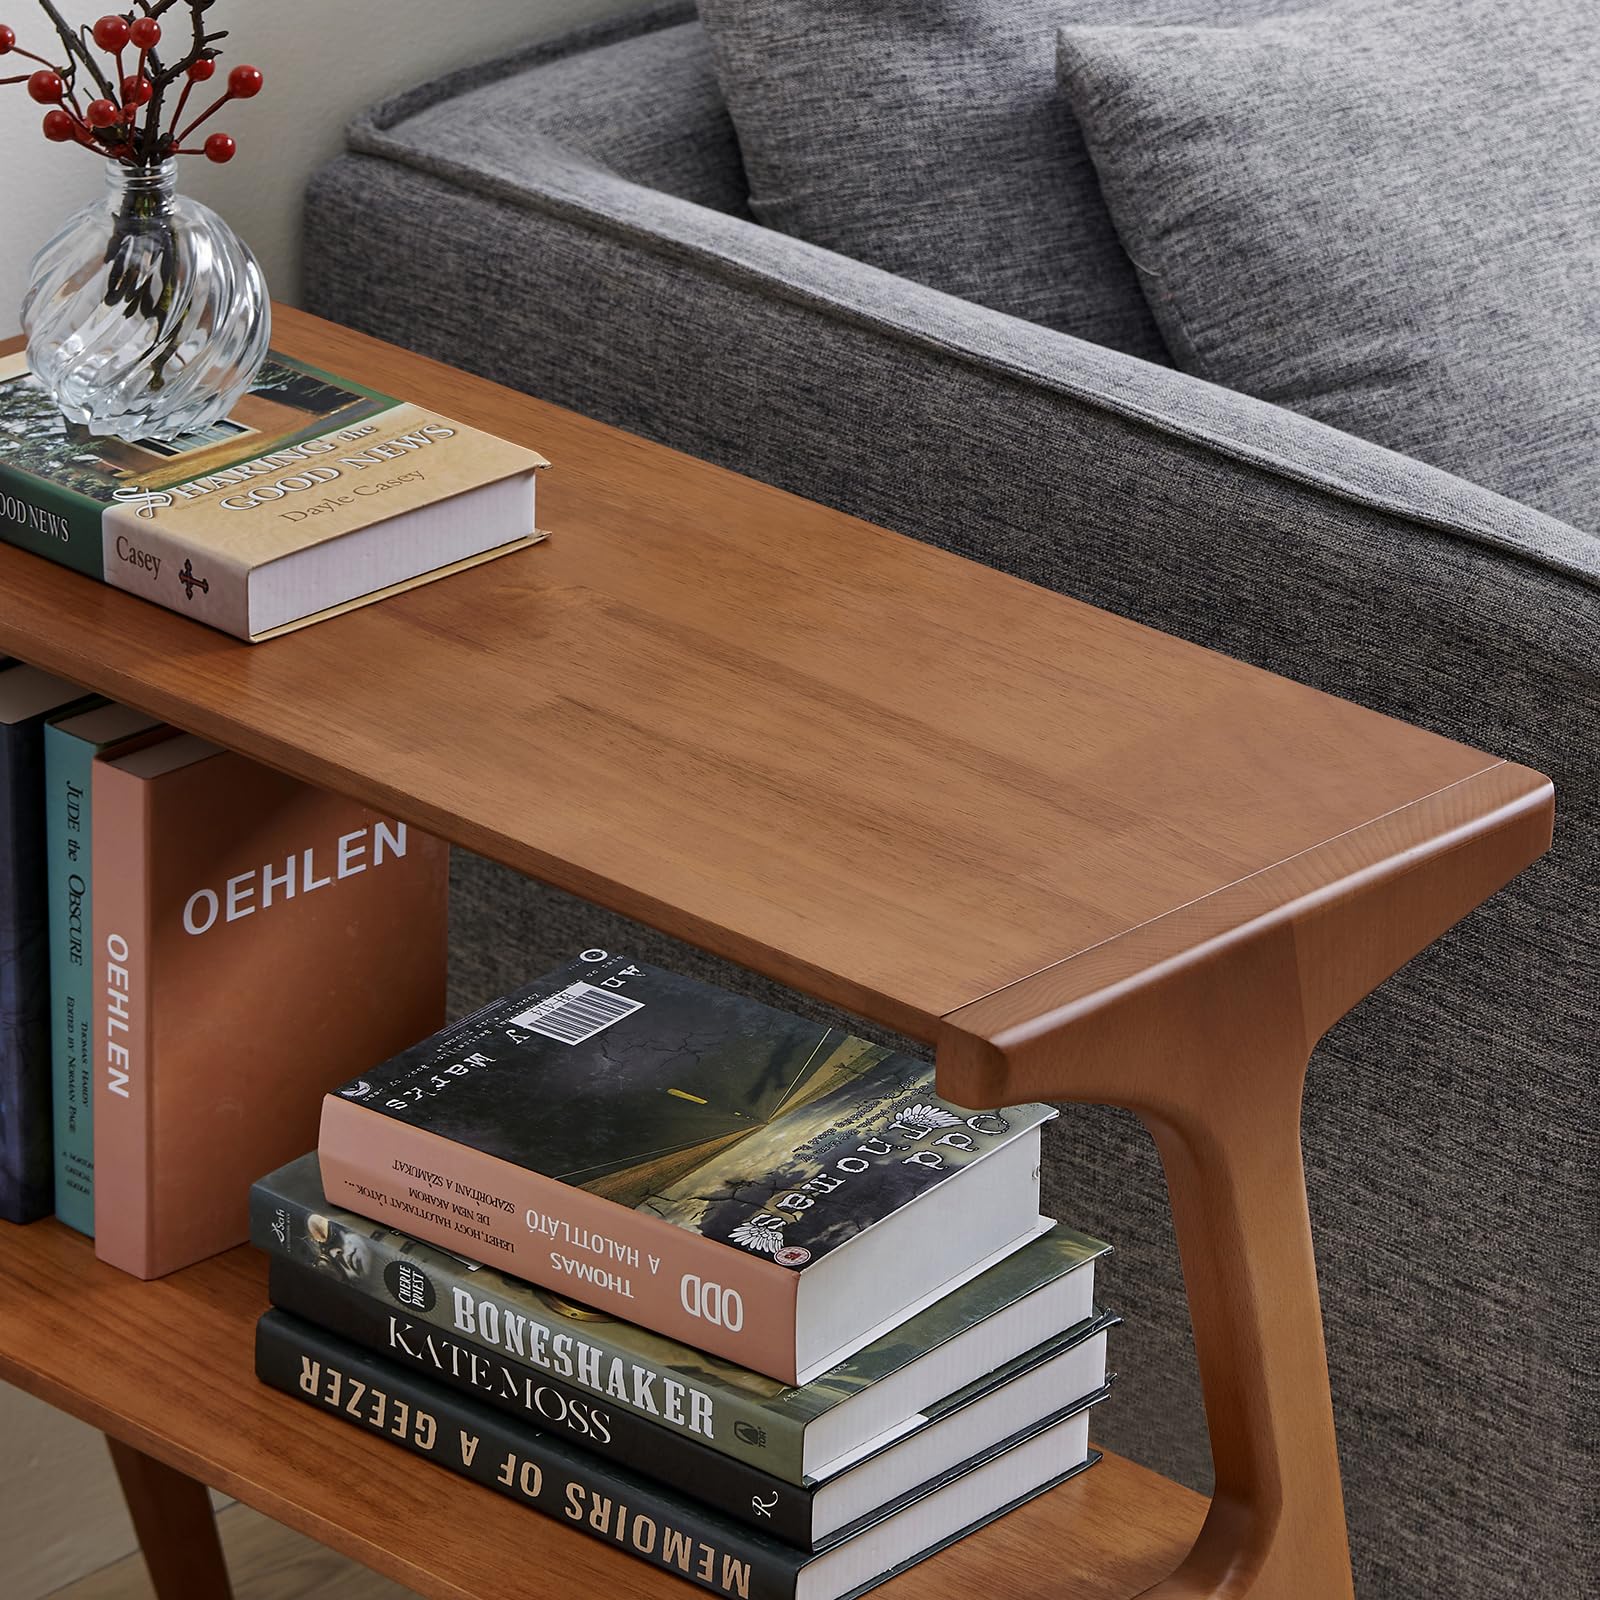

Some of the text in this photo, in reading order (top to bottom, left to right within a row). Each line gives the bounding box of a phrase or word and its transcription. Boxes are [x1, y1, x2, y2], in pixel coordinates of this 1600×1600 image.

[113, 438, 336, 519] SHARING
[336, 424, 378, 443] the
[219, 465, 342, 511] GOOD
[339, 423, 456, 471] NEWS
[279, 466, 426, 524] Dayle Casey
[28, 504, 70, 542] NEWS
[116, 535, 161, 580] Casey
[66, 780, 86, 967] JUDE the OBSCURE
[183, 821, 407, 936] OEHLEN
[107, 934, 129, 1098] OEHLEN
[386, 1051, 497, 1110] Marks
[901, 1113, 1011, 1171] Odd
[446, 1178, 456, 1189] A
[749, 1120, 934, 1231] Thomas
[390, 1197, 452, 1228] HALOTTAKAT
[408, 1187, 491, 1227] DE NEM AKAROM
[452, 1222, 481, 1241] HOGY
[481, 1232, 516, 1253] LEHET,
[524, 1208, 662, 1275] A HALOTTLÁTÓ
[398, 1264, 412, 1305] CHERIE
[411, 1270, 426, 1309] PRIEST
[549, 1251, 635, 1299] THOMAS
[679, 1273, 744, 1333] ODD
[388, 1316, 612, 1445] KATE MOSS
[452, 1286, 715, 1440] BONESHAKER
[299, 1355, 751, 1600] MEMOIRS OF A GEEZER
[751, 1490, 779, 1519] R
